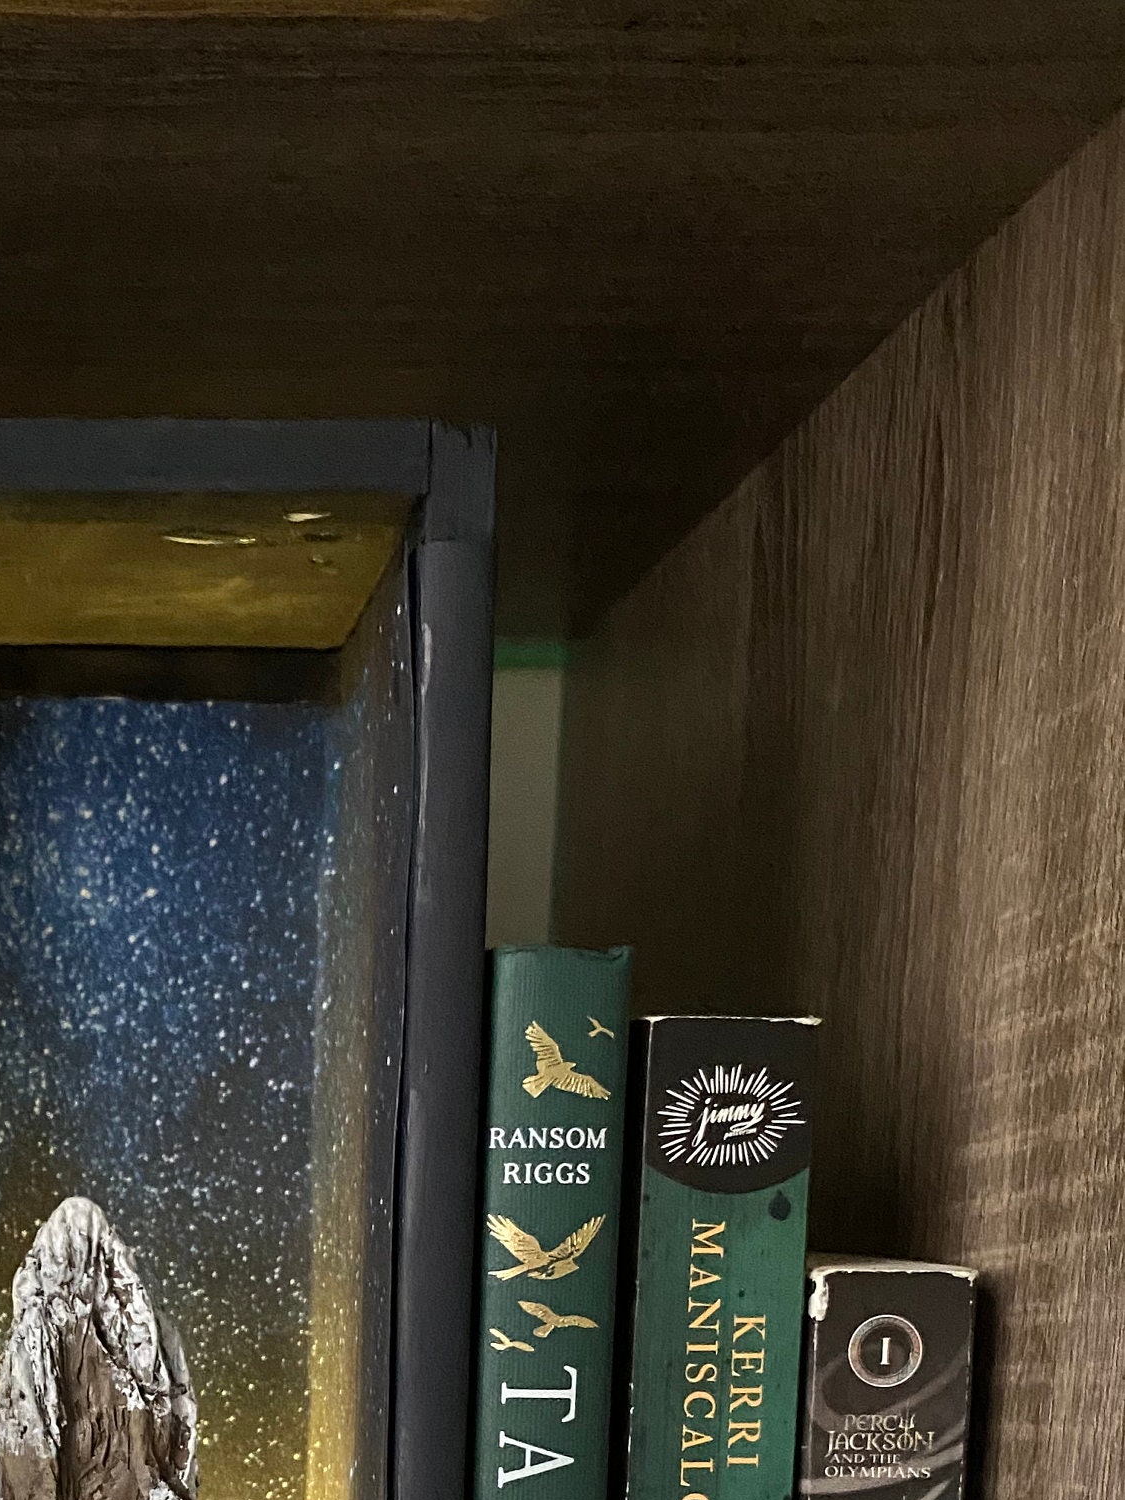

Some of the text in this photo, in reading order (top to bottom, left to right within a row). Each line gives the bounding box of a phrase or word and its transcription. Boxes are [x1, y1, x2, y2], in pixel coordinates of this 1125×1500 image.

[691, 1098, 765, 1147] jimmy
[489, 1127, 608, 1150] RANSOM
[502, 1162, 591, 1185] RIGGS
[726, 1315, 767, 1468] KERRI
[843, 1413, 916, 1432] PERCY
[825, 1430, 935, 1458] JACKSON
[830, 1453, 900, 1464] AND THE
[825, 1465, 931, 1479] OLYMPIANS
